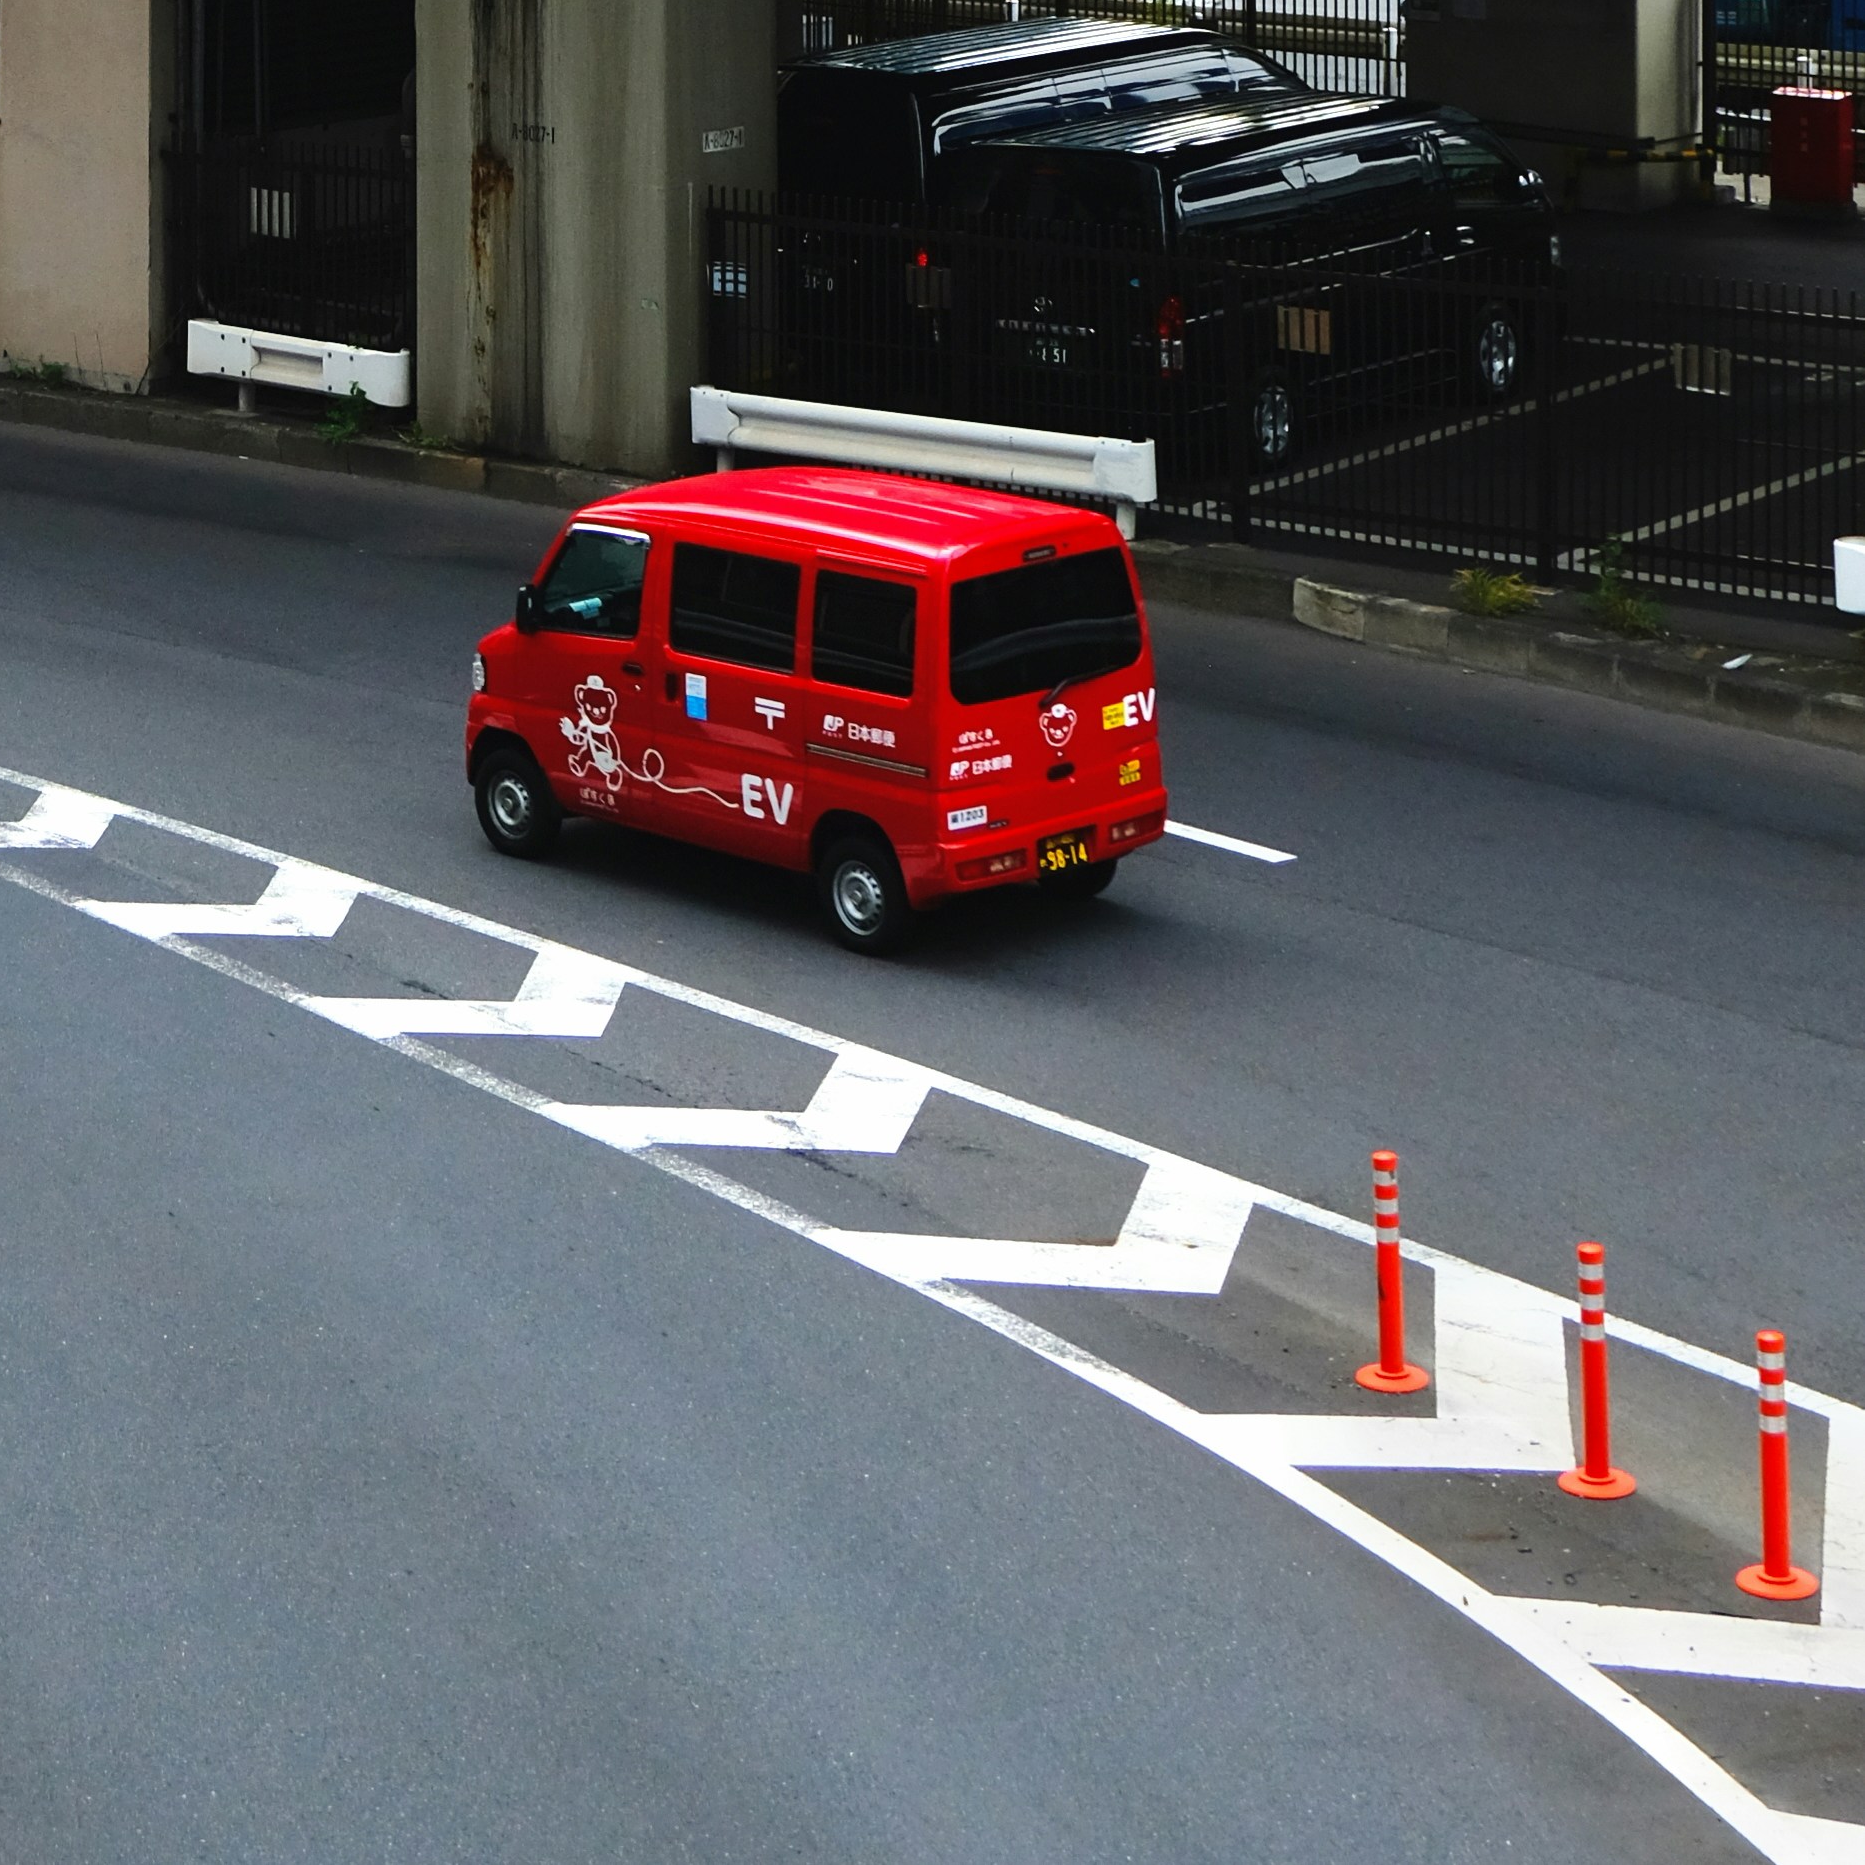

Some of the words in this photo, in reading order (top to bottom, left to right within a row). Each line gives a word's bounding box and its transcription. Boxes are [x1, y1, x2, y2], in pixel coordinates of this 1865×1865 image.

[1122, 687, 1156, 727] EV
[848, 722, 896, 748] 日本郵便
[972, 754, 1012, 775] 日本郵便
[741, 773, 794, 826] EV
[1046, 842, 1088, 871] 98-14
